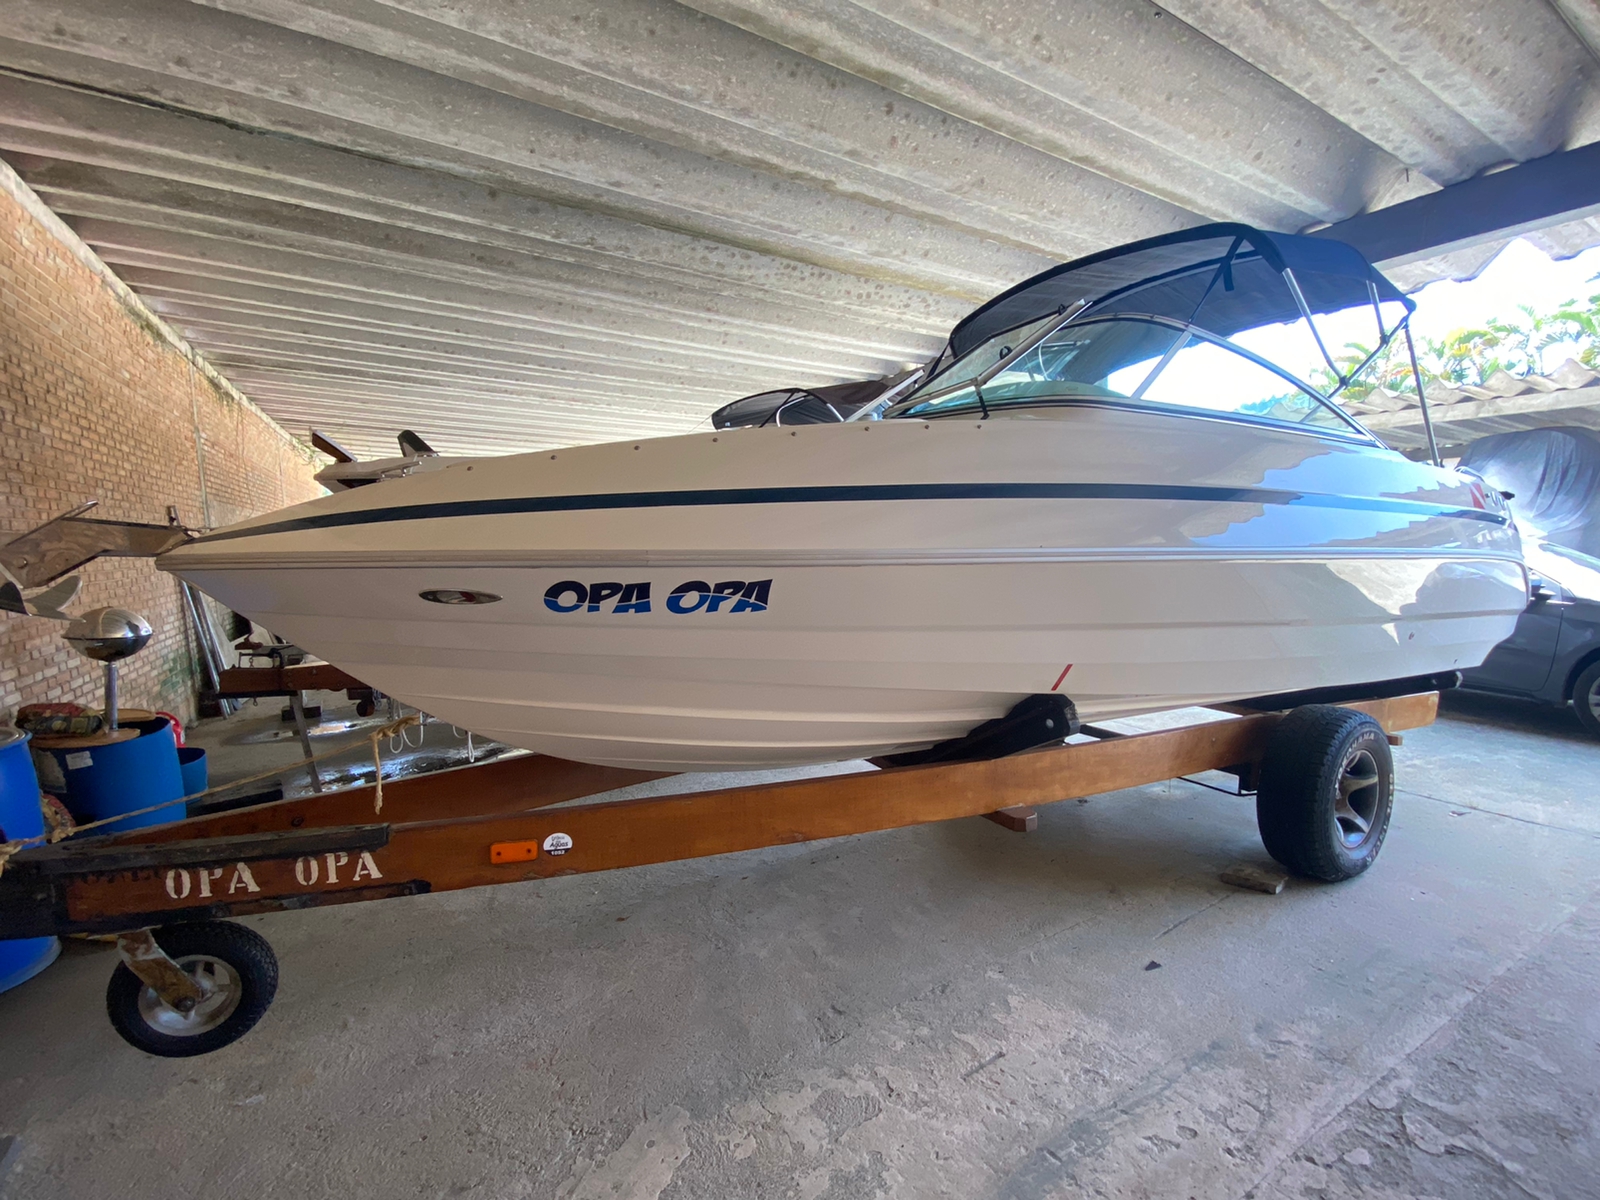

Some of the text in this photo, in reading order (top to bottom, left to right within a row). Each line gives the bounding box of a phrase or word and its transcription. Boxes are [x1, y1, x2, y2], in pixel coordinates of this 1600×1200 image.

[543, 578, 774, 615] OPA OPA
[165, 850, 383, 900] OPA OPA
